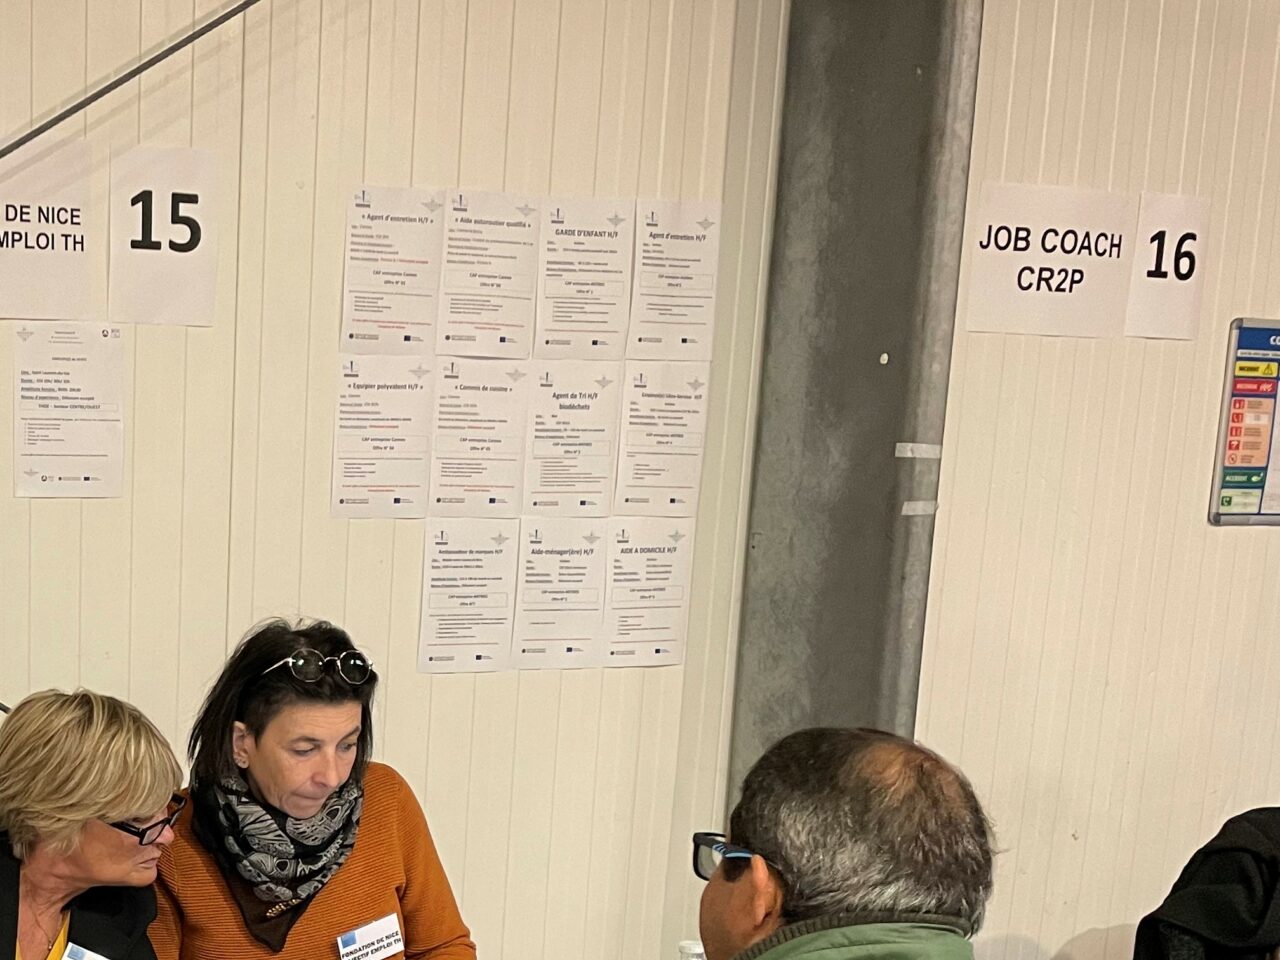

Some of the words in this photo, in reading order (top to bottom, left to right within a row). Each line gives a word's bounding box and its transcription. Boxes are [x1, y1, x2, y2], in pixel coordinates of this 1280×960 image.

[5, 204, 31, 223] DE
[38, 205, 81, 225] NICE
[130, 190, 201, 253] 15
[60, 233, 84, 252] TH
[979, 224, 1031, 252] JOB
[1040, 228, 1122, 258] COACH
[1146, 230, 1197, 281] 16
[1017, 265, 1084, 293] CR2P
[342, 941, 375, 959] FONDATION
[385, 931, 399, 941] NICE
[371, 942, 392, 955] EMPLOI
